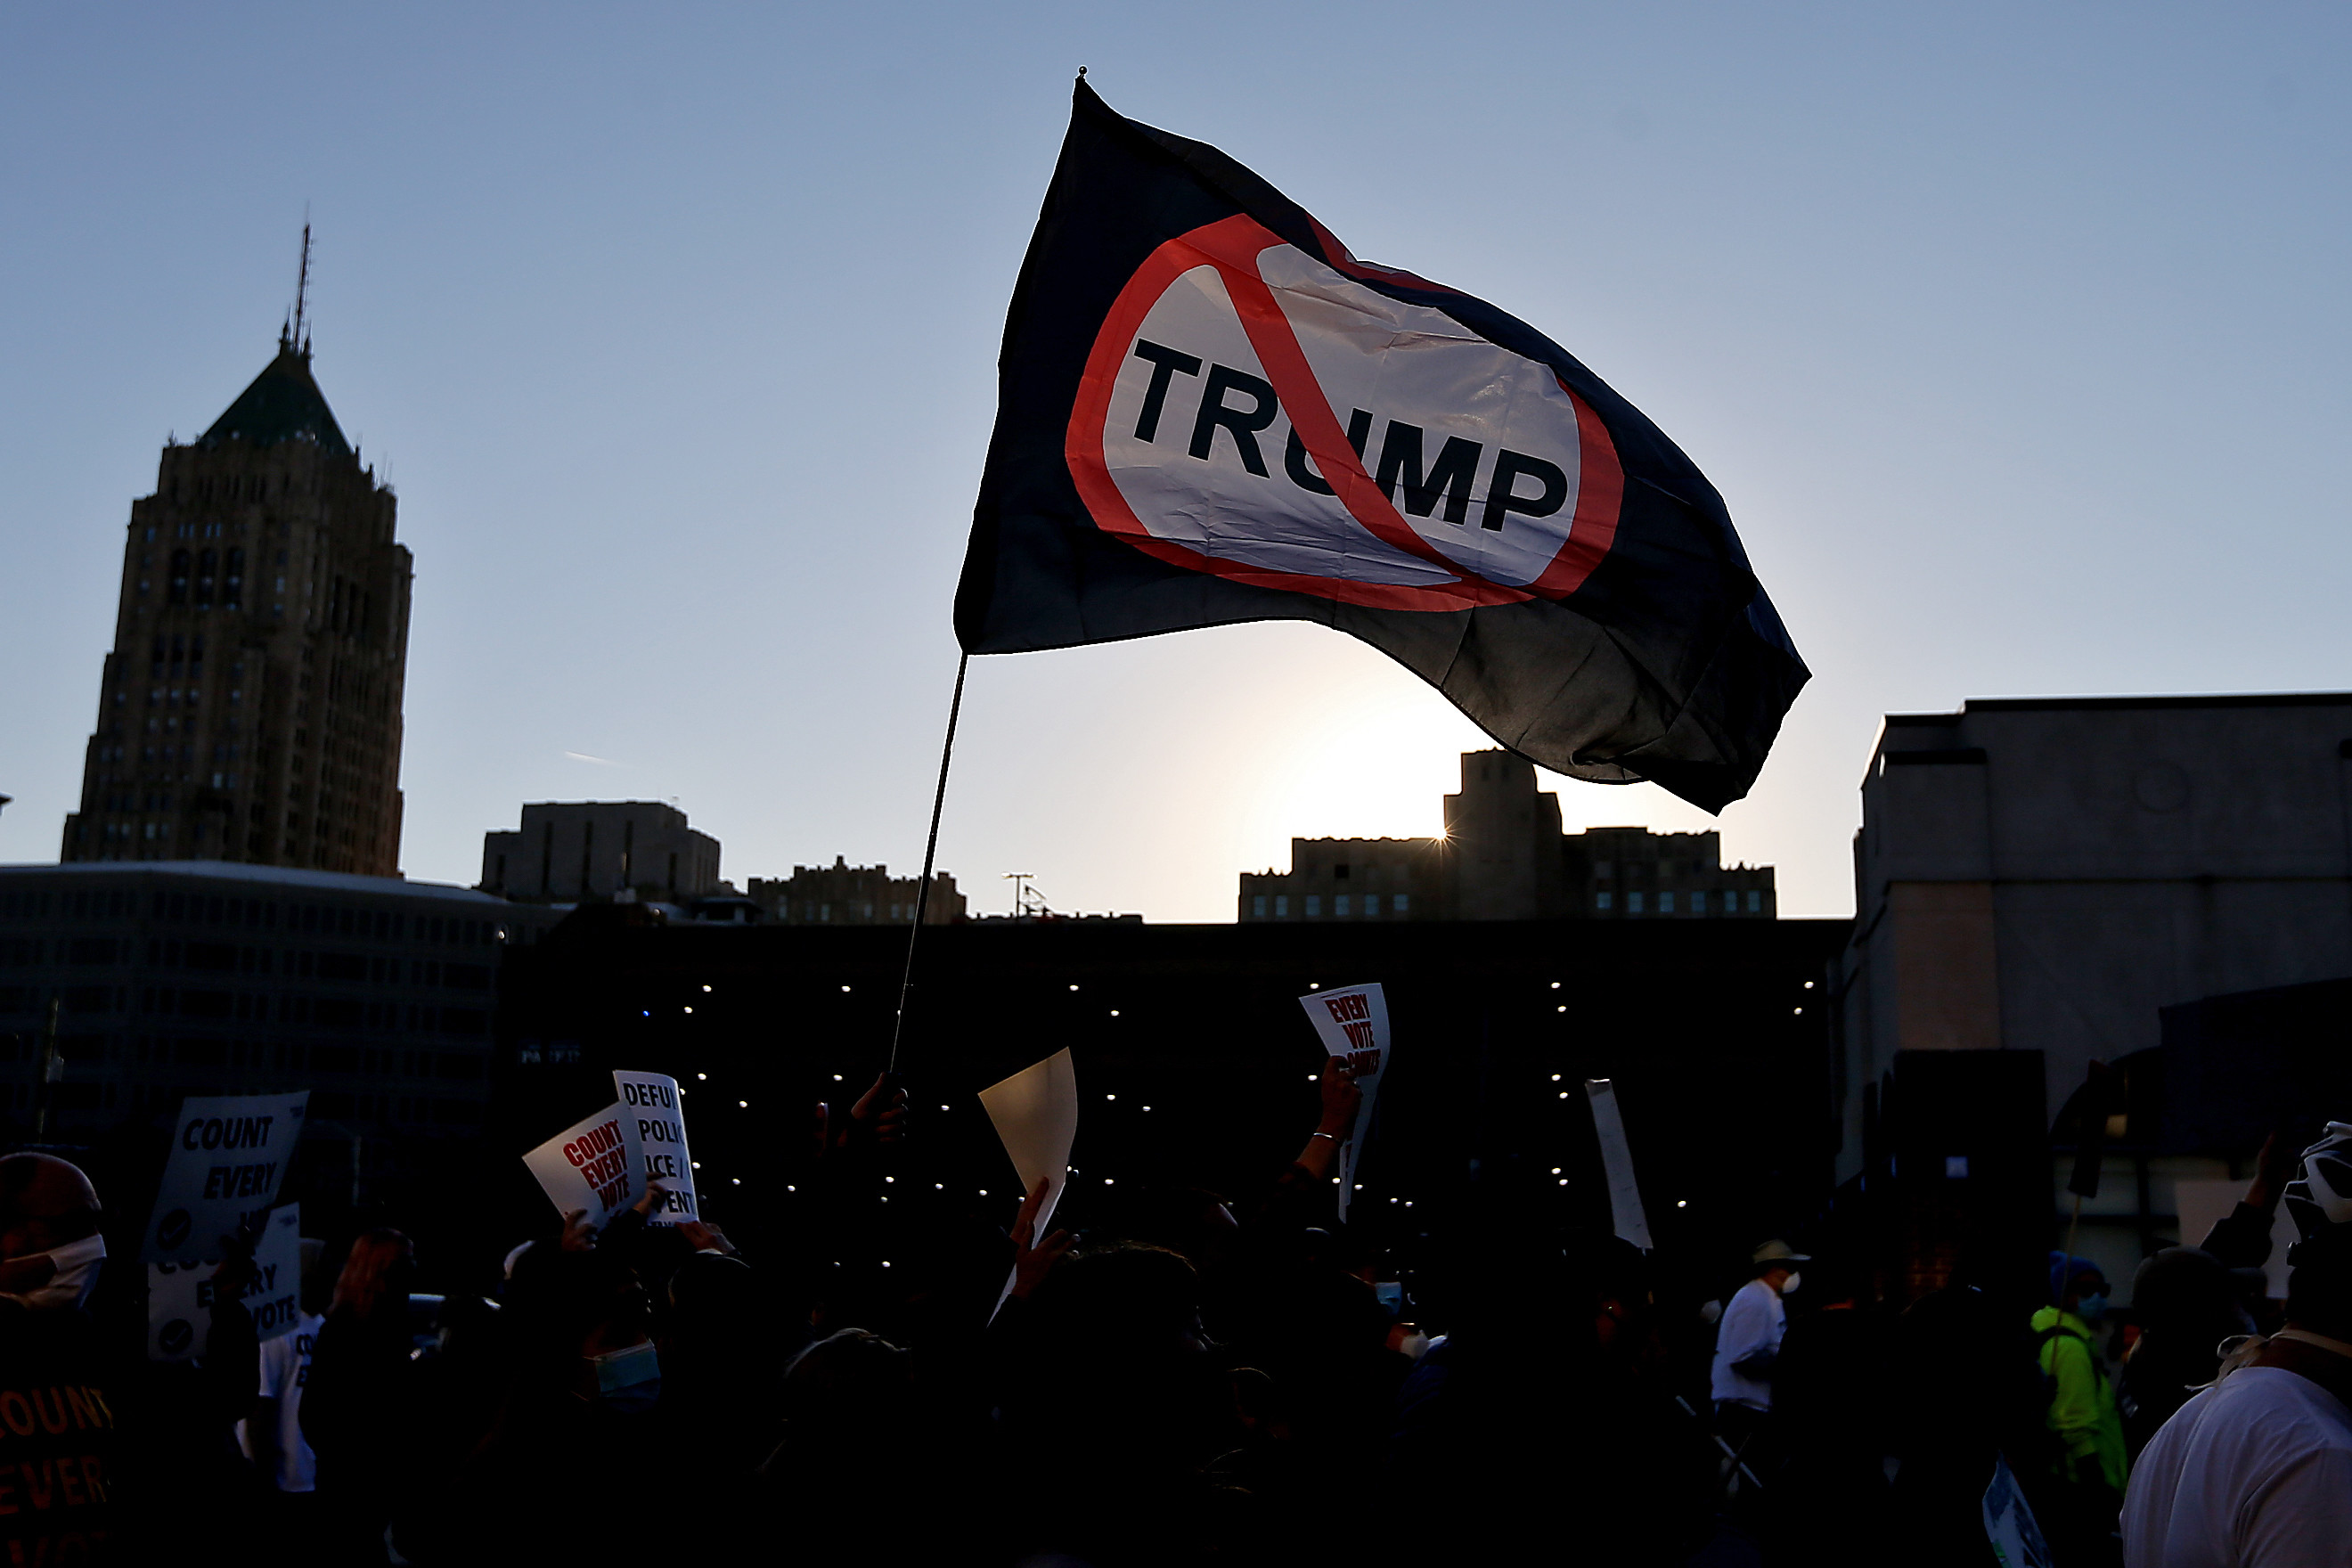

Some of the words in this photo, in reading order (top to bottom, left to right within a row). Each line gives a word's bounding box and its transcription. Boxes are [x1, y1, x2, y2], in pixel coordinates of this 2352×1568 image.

[1134, 339, 1568, 532] TRUMP
[1325, 994, 1370, 1023] EVERY
[1342, 1022, 1375, 1049] VOTE
[184, 1116, 274, 1150] COUNT
[563, 1119, 623, 1167] COUNT
[203, 1162, 277, 1199] EVERY
[580, 1145, 627, 1189] EVERY
[646, 1155, 677, 1178] ICE
[597, 1173, 630, 1213] VOTE
[0, 1384, 114, 1440] OUNT
